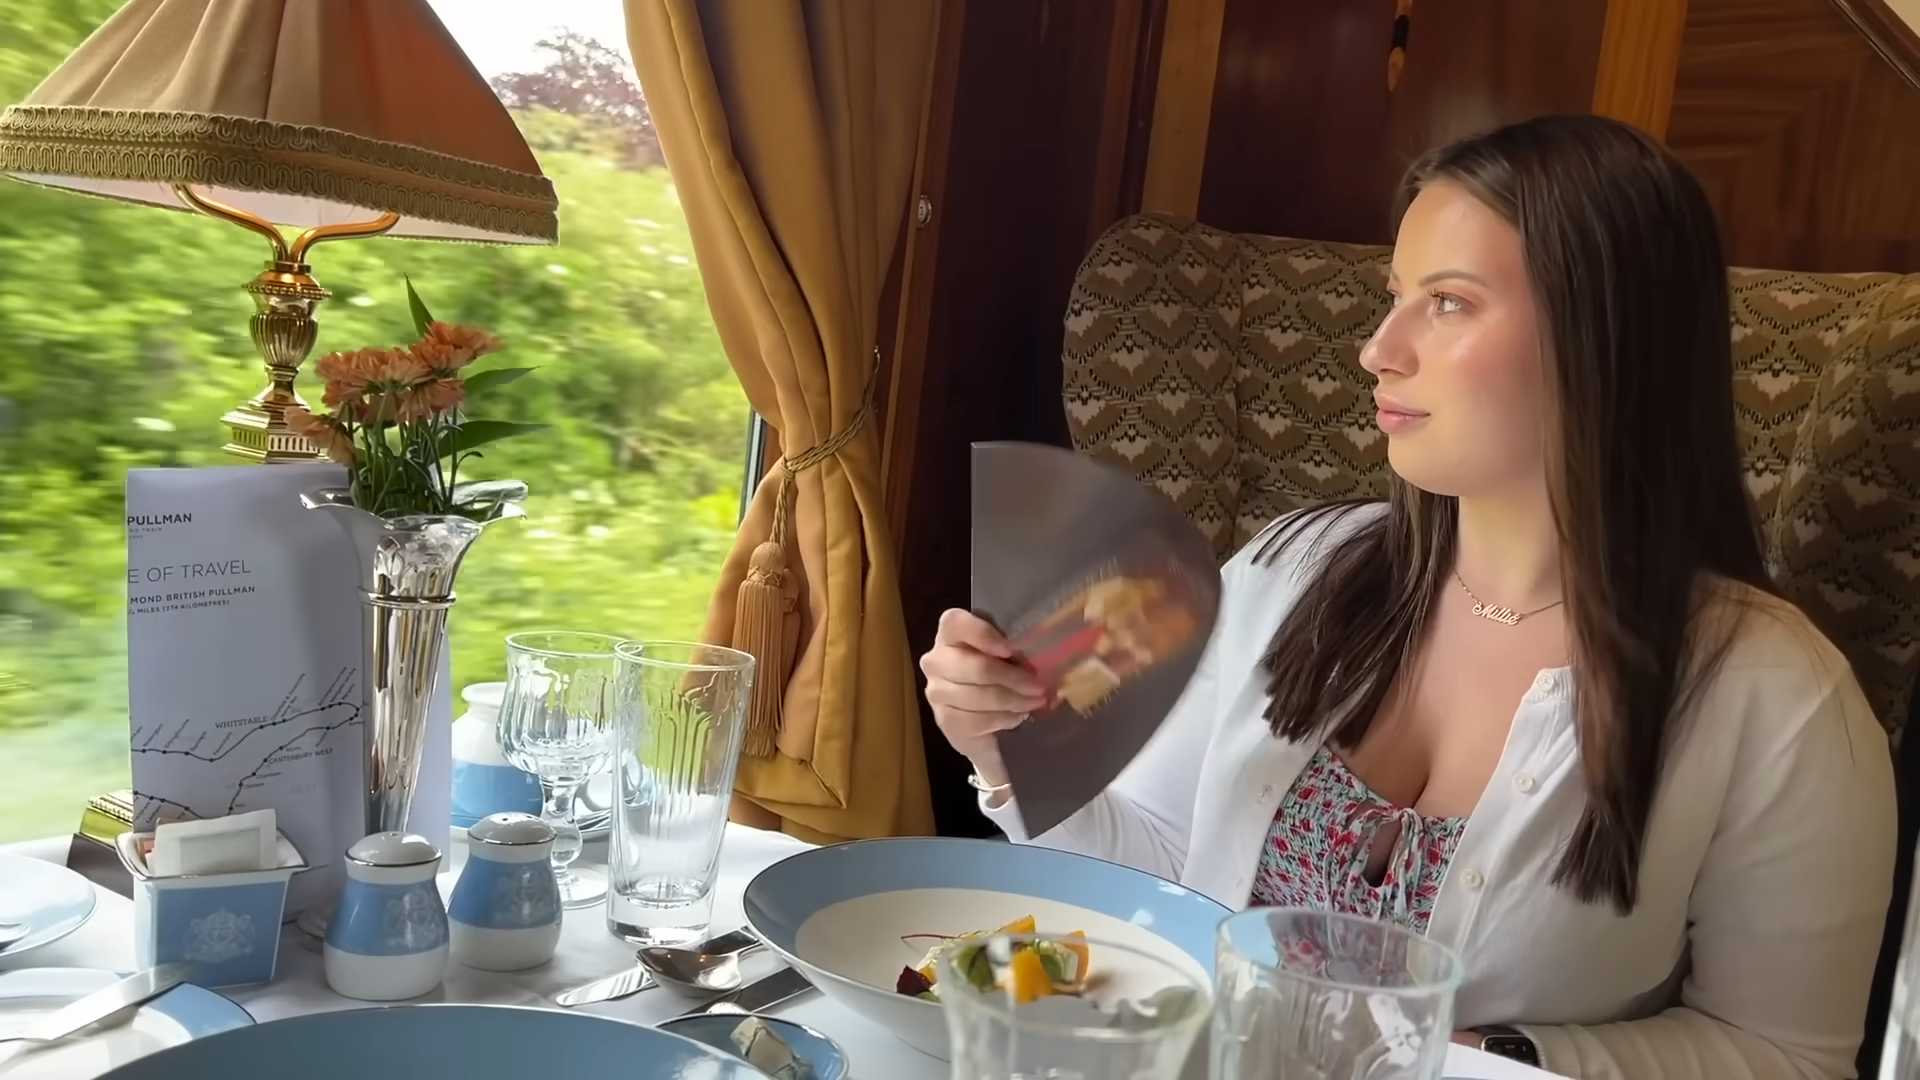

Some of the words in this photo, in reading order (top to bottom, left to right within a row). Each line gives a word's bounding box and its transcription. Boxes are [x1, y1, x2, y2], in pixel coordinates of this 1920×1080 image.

[127, 513, 192, 526] PULLMAN
[127, 568, 139, 584] E
[146, 566, 174, 582] OF
[181, 560, 251, 578] TRAVEL
[130, 596, 162, 604] MOND
[166, 591, 205, 601] BRITISH
[208, 586, 255, 596] PULLMAN
[137, 606, 160, 614] MILES
[1472, 603, 1521, 626] Millie
[215, 716, 268, 729] WHITSTABLE
